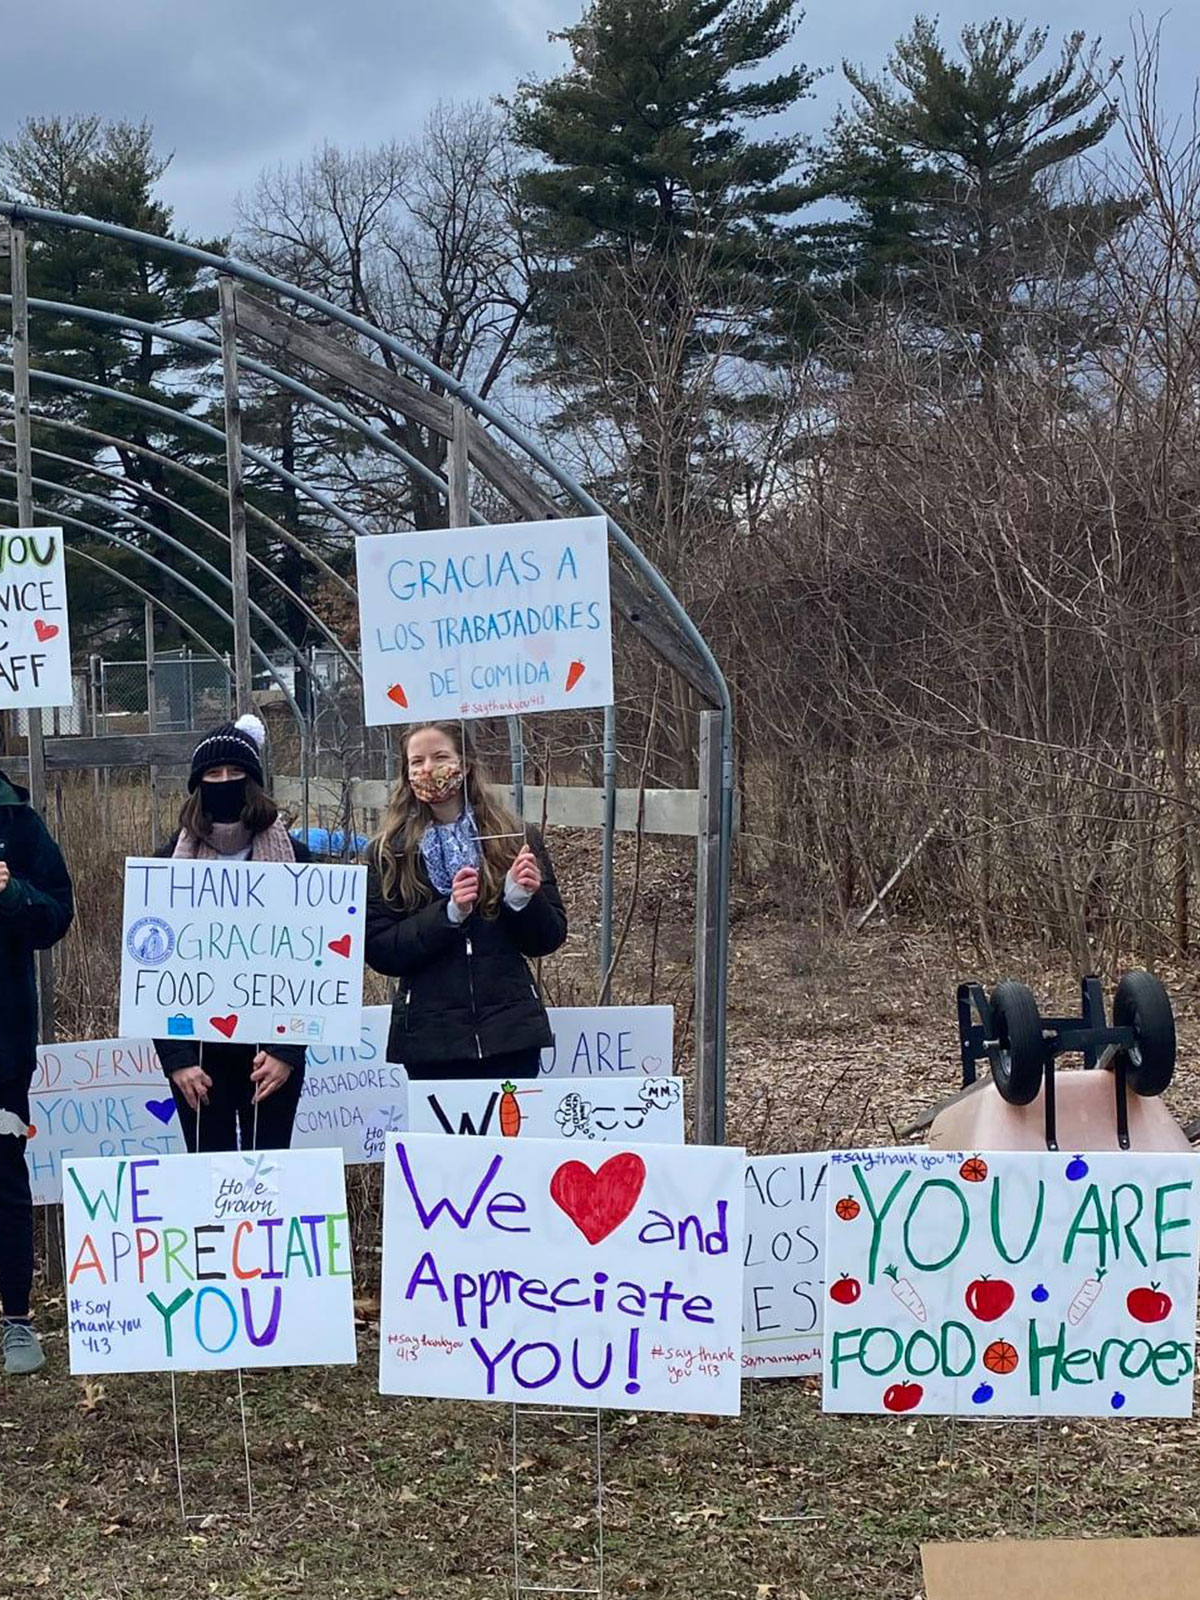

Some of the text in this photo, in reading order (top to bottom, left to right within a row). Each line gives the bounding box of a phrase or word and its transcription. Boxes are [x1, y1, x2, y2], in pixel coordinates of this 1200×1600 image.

[387, 547, 578, 600] GRACIAS A
[377, 601, 601, 653] LOS TRABAJADORES
[430, 660, 550, 697] DE COMIDA
[127, 864, 357, 915] THANK YOU!
[176, 922, 324, 967] GRACIAS!
[135, 969, 350, 1009] FOOD SERVICE
[73, 1045, 163, 1085] SERVIC
[571, 1031, 636, 1075] ARE
[300, 1068, 400, 1097] ABAJADORES
[36, 1096, 146, 1135] YOU'RE
[295, 1106, 364, 1133] COMIDA
[364, 1140, 385, 1158] Gro
[67, 1159, 163, 1223] WE
[214, 1195, 276, 1218] Grown
[396, 1142, 728, 1255] We and
[745, 1162, 827, 1207] ACIA
[744, 1225, 819, 1266] LOS
[852, 1164, 1192, 1285] YOU ARE
[69, 1212, 353, 1285] APPRECIATE
[405, 1251, 715, 1329] Appreciate
[146, 1286, 282, 1357] YOU
[82, 1336, 111, 1355] 413
[397, 1347, 417, 1361] 413
[470, 1327, 641, 1395] YOU!
[831, 1318, 1193, 1396] FOOD Heroes
[668, 1365, 720, 1384] you 413
